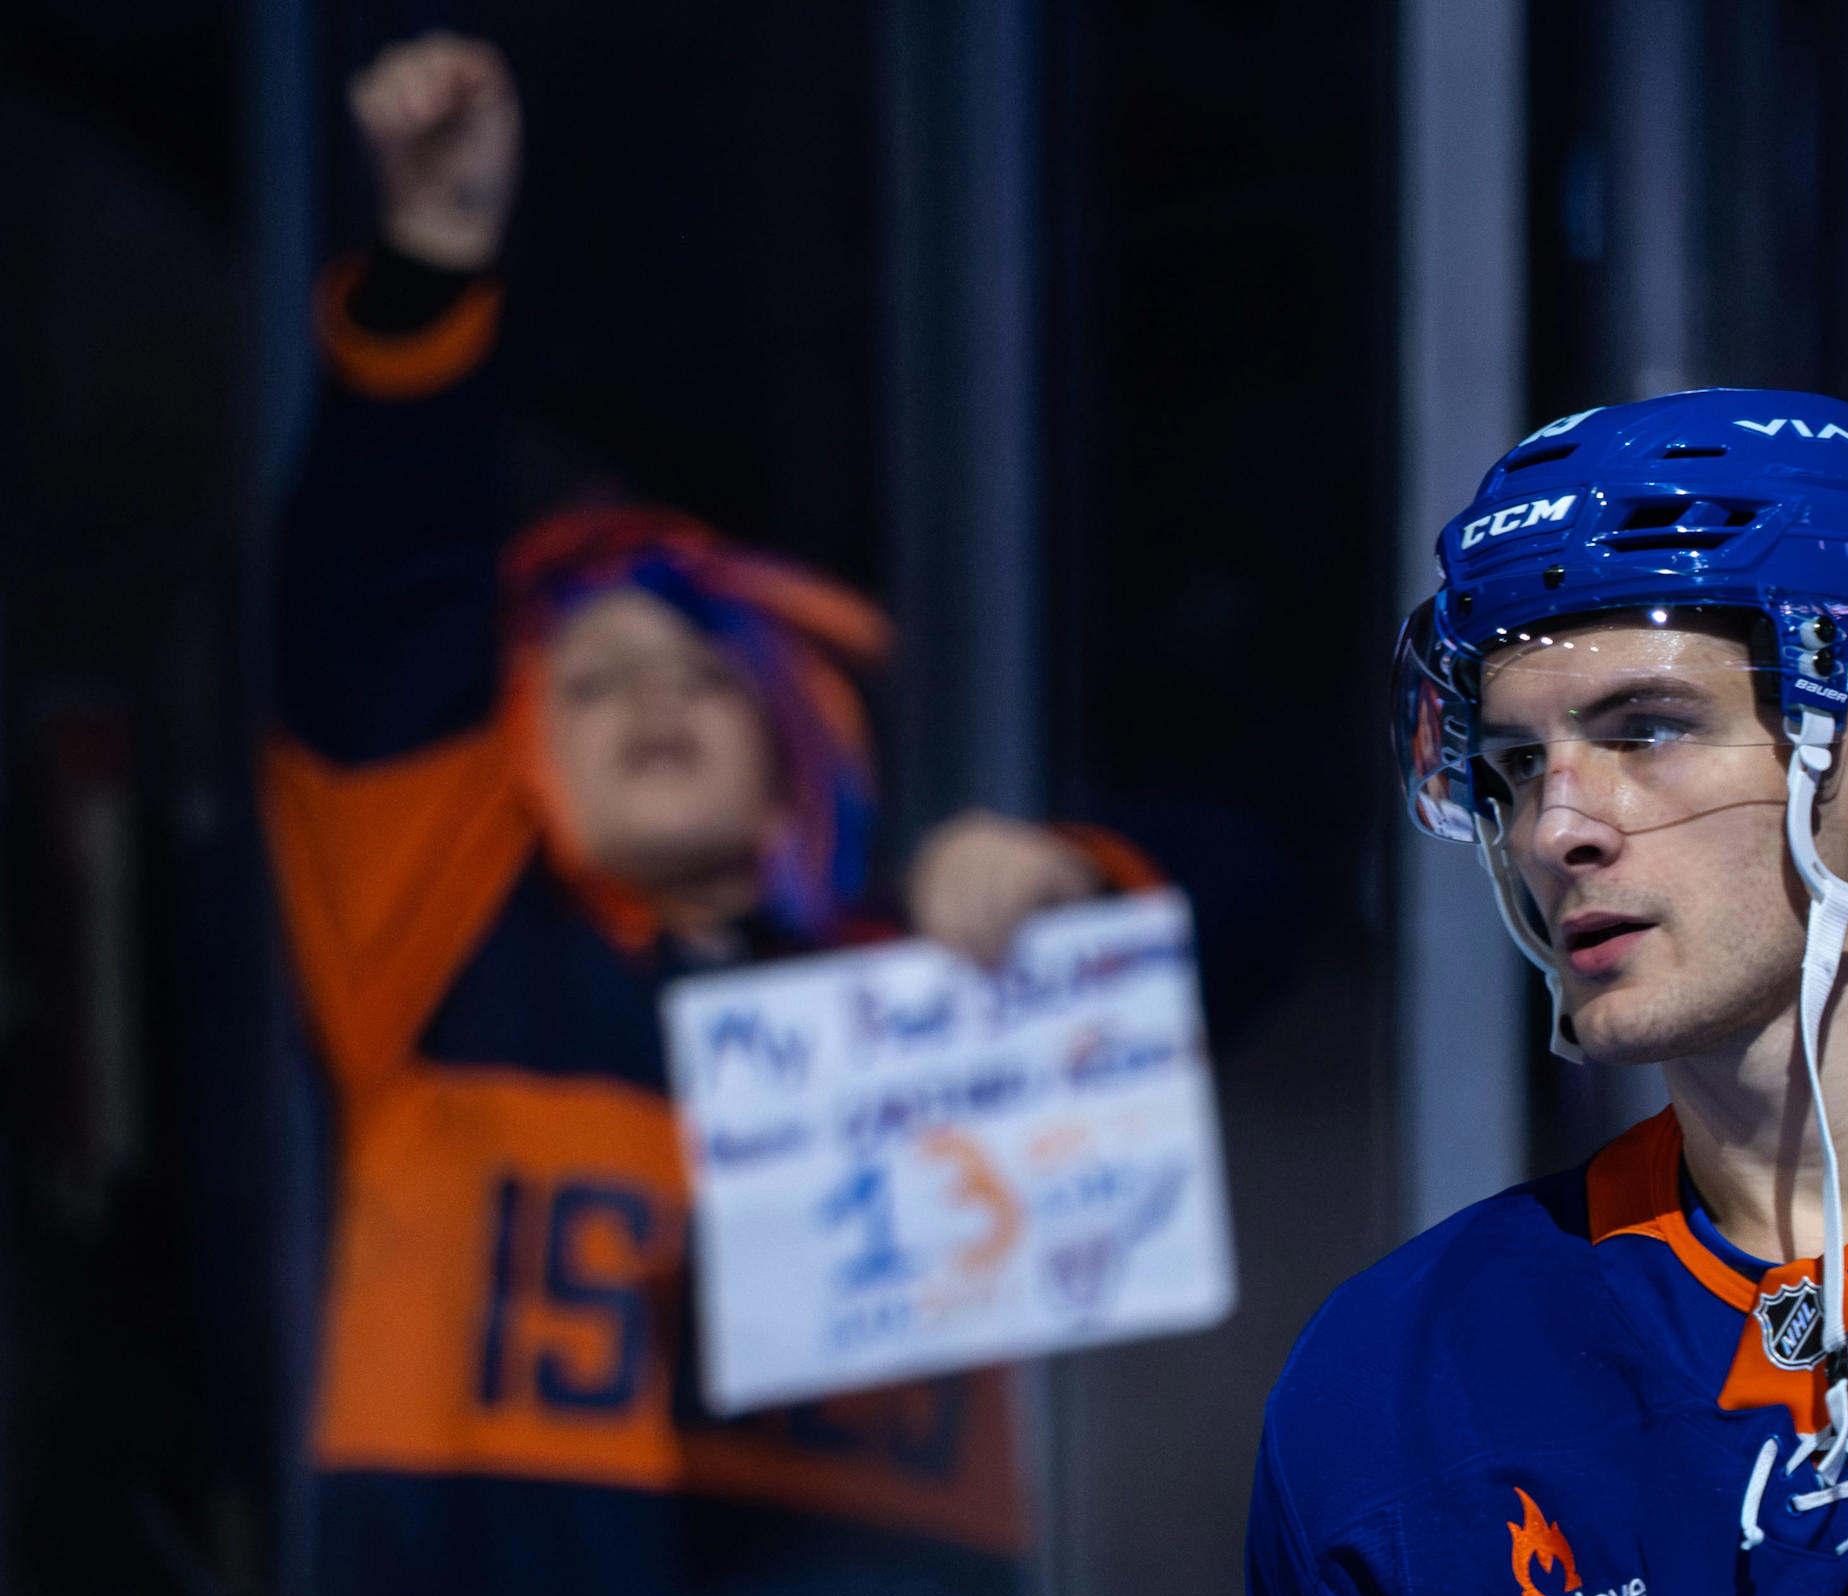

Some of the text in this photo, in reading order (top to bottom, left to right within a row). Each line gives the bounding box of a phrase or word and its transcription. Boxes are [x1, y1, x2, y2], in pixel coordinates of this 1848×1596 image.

[1460, 494, 1578, 550] CCM
[1794, 678, 1848, 704] BAUER
[810, 1122, 1028, 1296] 13
[1780, 1300, 1818, 1357] NHL
